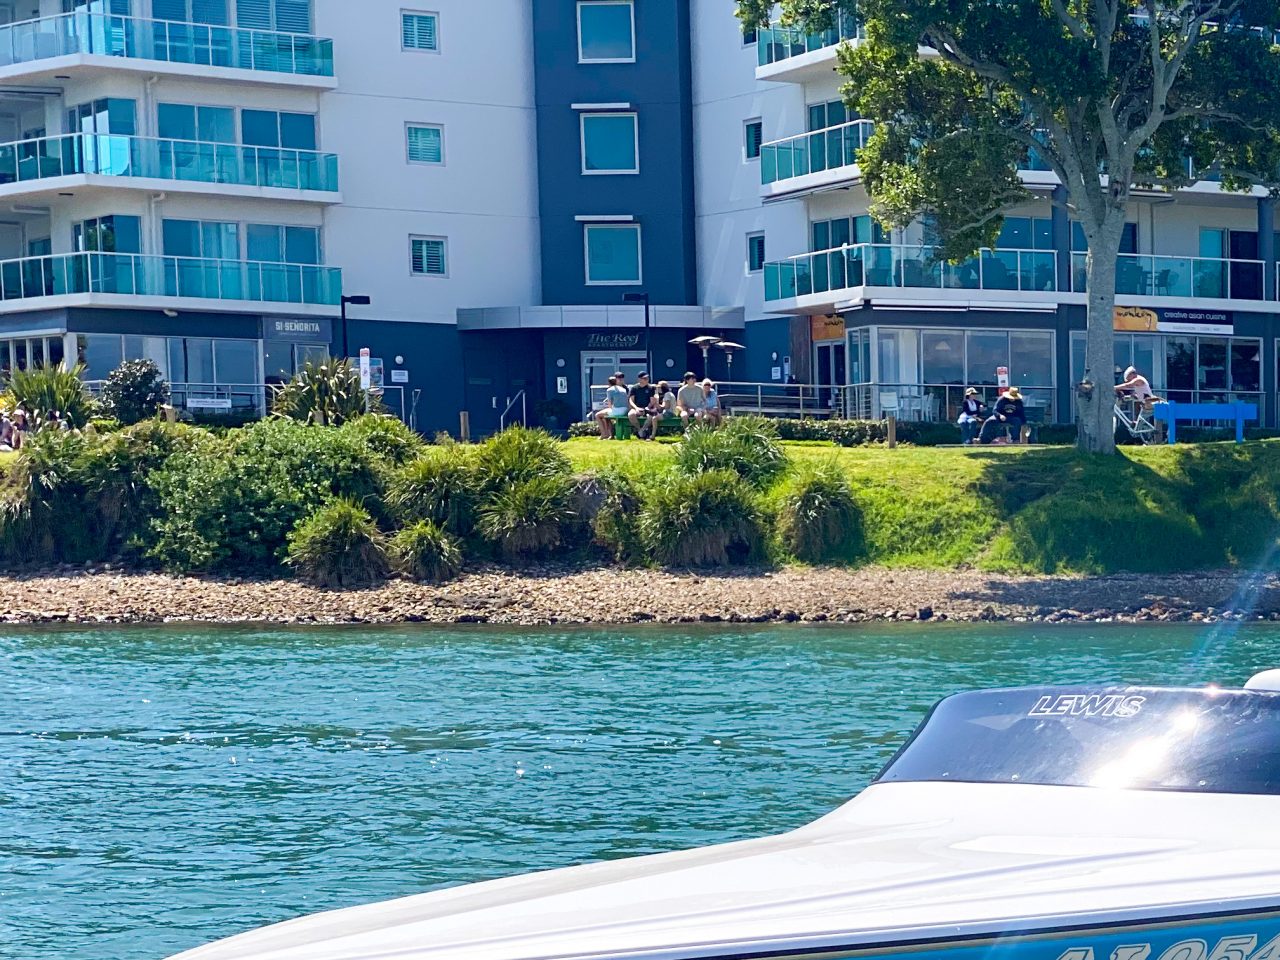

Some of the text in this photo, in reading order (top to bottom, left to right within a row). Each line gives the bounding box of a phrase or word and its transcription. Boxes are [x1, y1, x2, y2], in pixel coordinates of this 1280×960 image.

[275, 321, 283, 331] SI
[587, 332, 643, 346] The Reef
[1028, 694, 1147, 717] LEWIS
